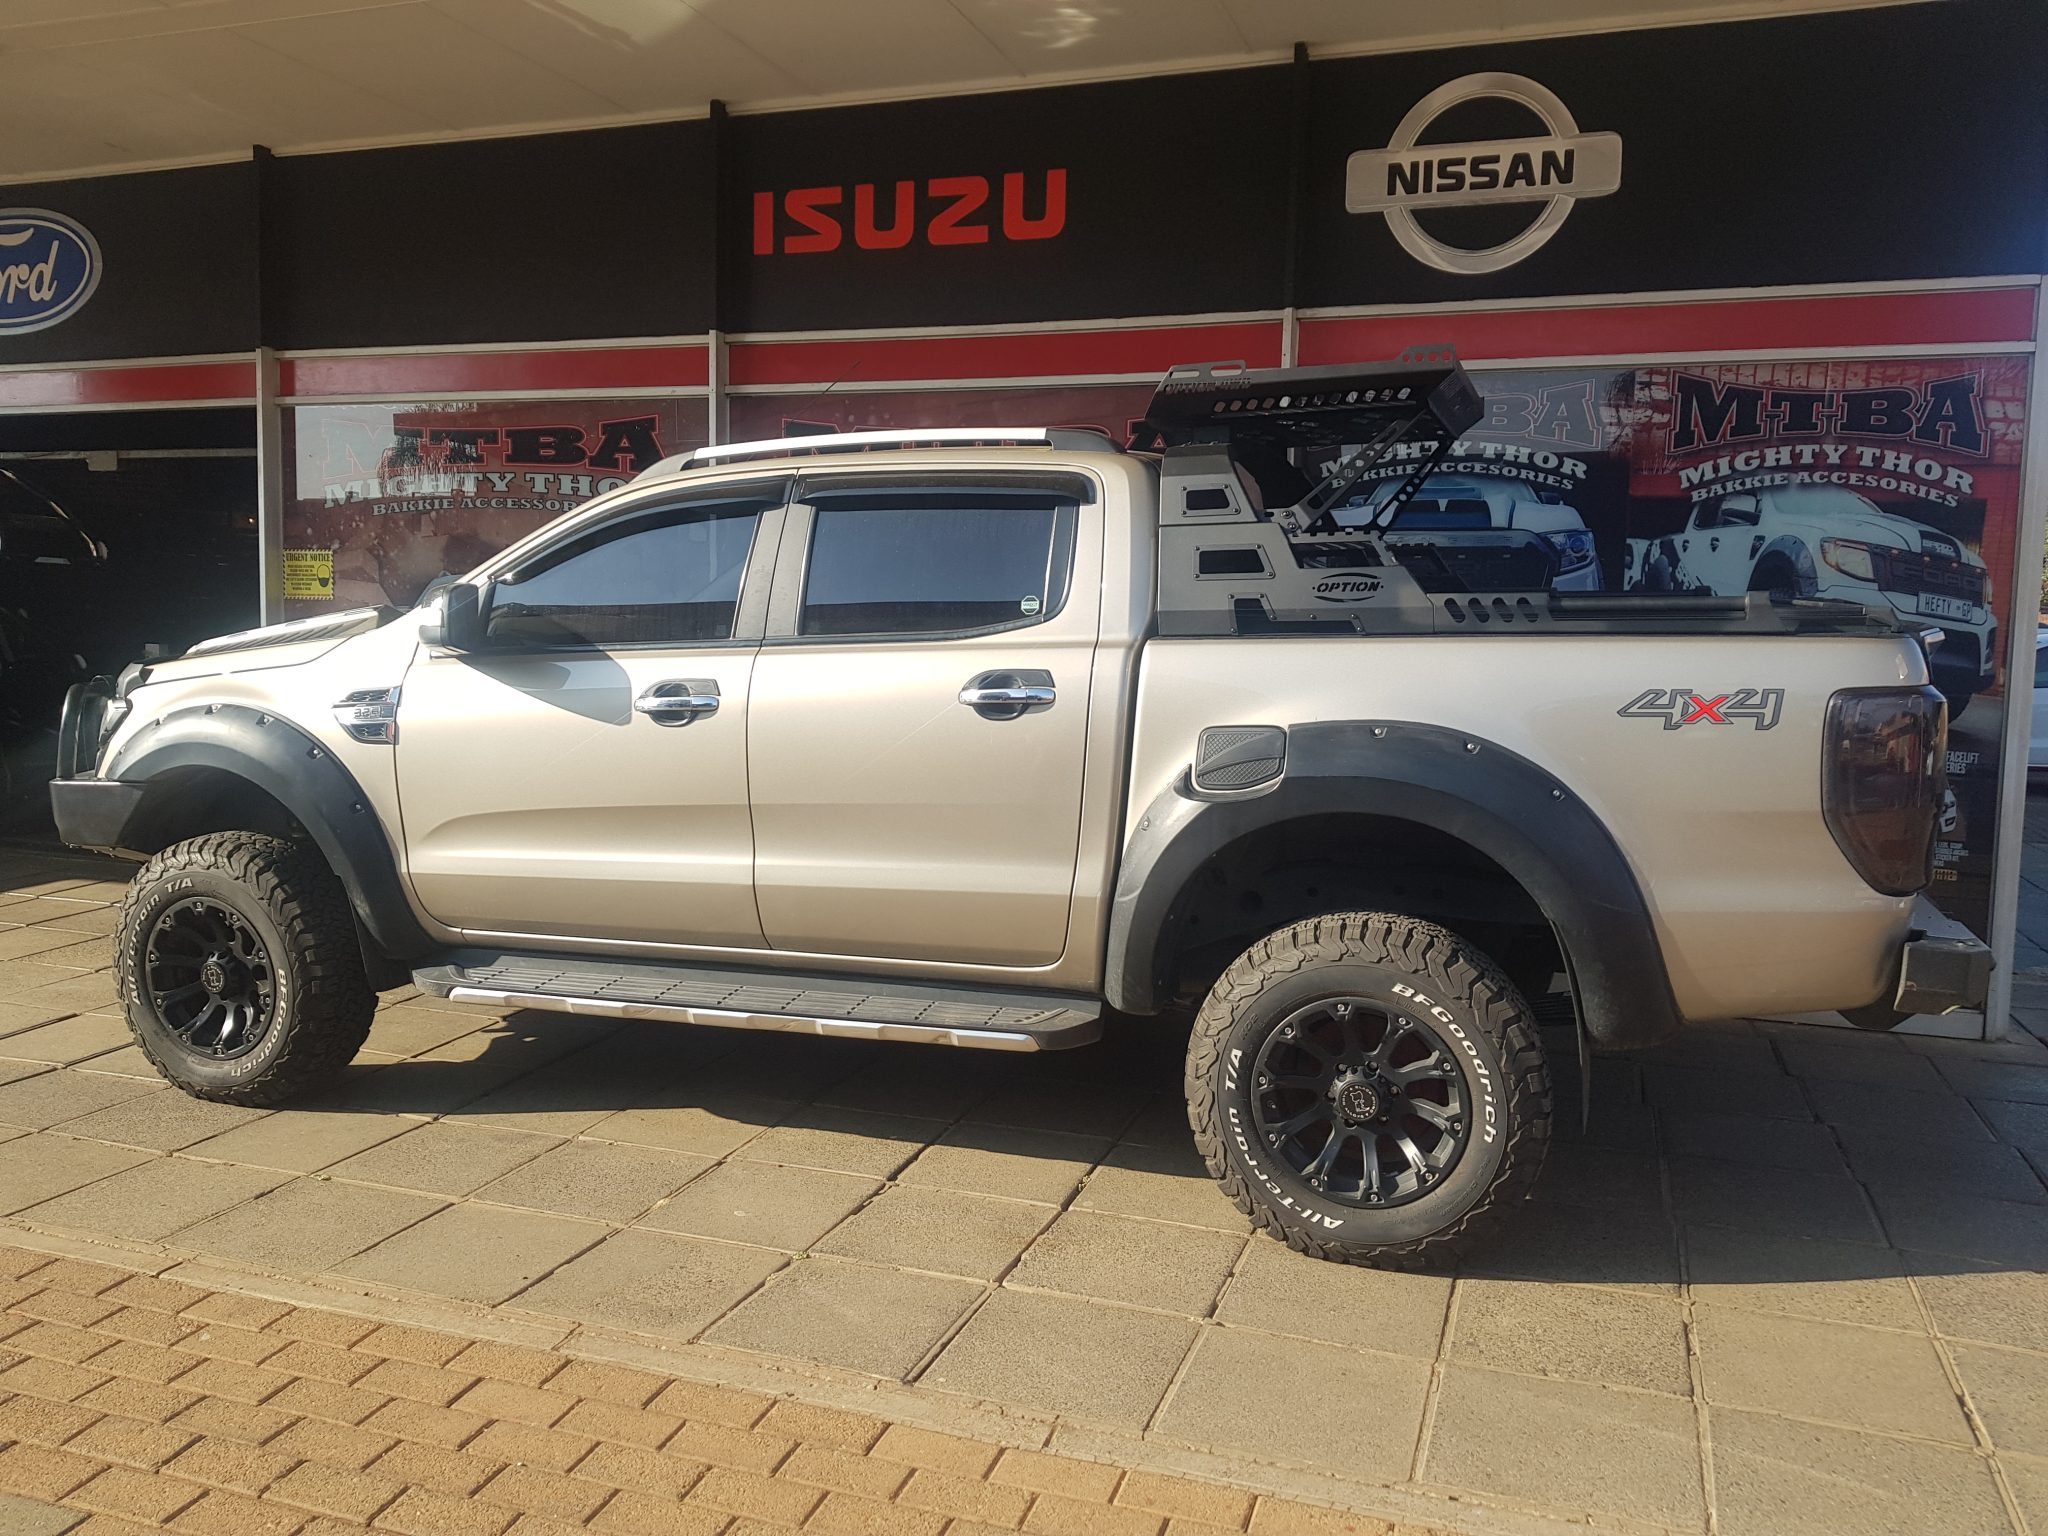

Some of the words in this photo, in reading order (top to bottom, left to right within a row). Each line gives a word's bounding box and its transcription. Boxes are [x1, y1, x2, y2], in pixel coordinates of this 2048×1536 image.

[1387, 149, 1574, 196] NISSAN
[753, 168, 1067, 256] ISUZU
[0, 227, 59, 304] rd
[1460, 378, 1602, 450] BA
[1665, 369, 1990, 458] MTBA
[1320, 440, 1473, 478] MHTY
[1479, 441, 1588, 479] THOR
[1330, 463, 1419, 489] BKKIE
[1678, 444, 1848, 489] MIGHTY
[1856, 445, 1974, 494] THOR
[322, 471, 516, 508] MIGHTY
[524, 472, 628, 499] THO
[372, 498, 454, 516] BAKKIE
[460, 497, 581, 512] ACCESSOR
[1691, 473, 1789, 502] BAKKIE
[1796, 472, 1959, 507] ACCESORIES
[310, 553, 331, 562] NOTICE
[1316, 582, 1380, 593] OPTION
[1925, 596, 1952, 614] HEFTY
[1946, 762, 1967, 774] ERIES
[164, 877, 194, 894] T/A
[230, 968, 289, 1078] BFGoodrich
[1225, 1048, 1243, 1091] T/A
[1391, 983, 1498, 1144] BFGoodrich
